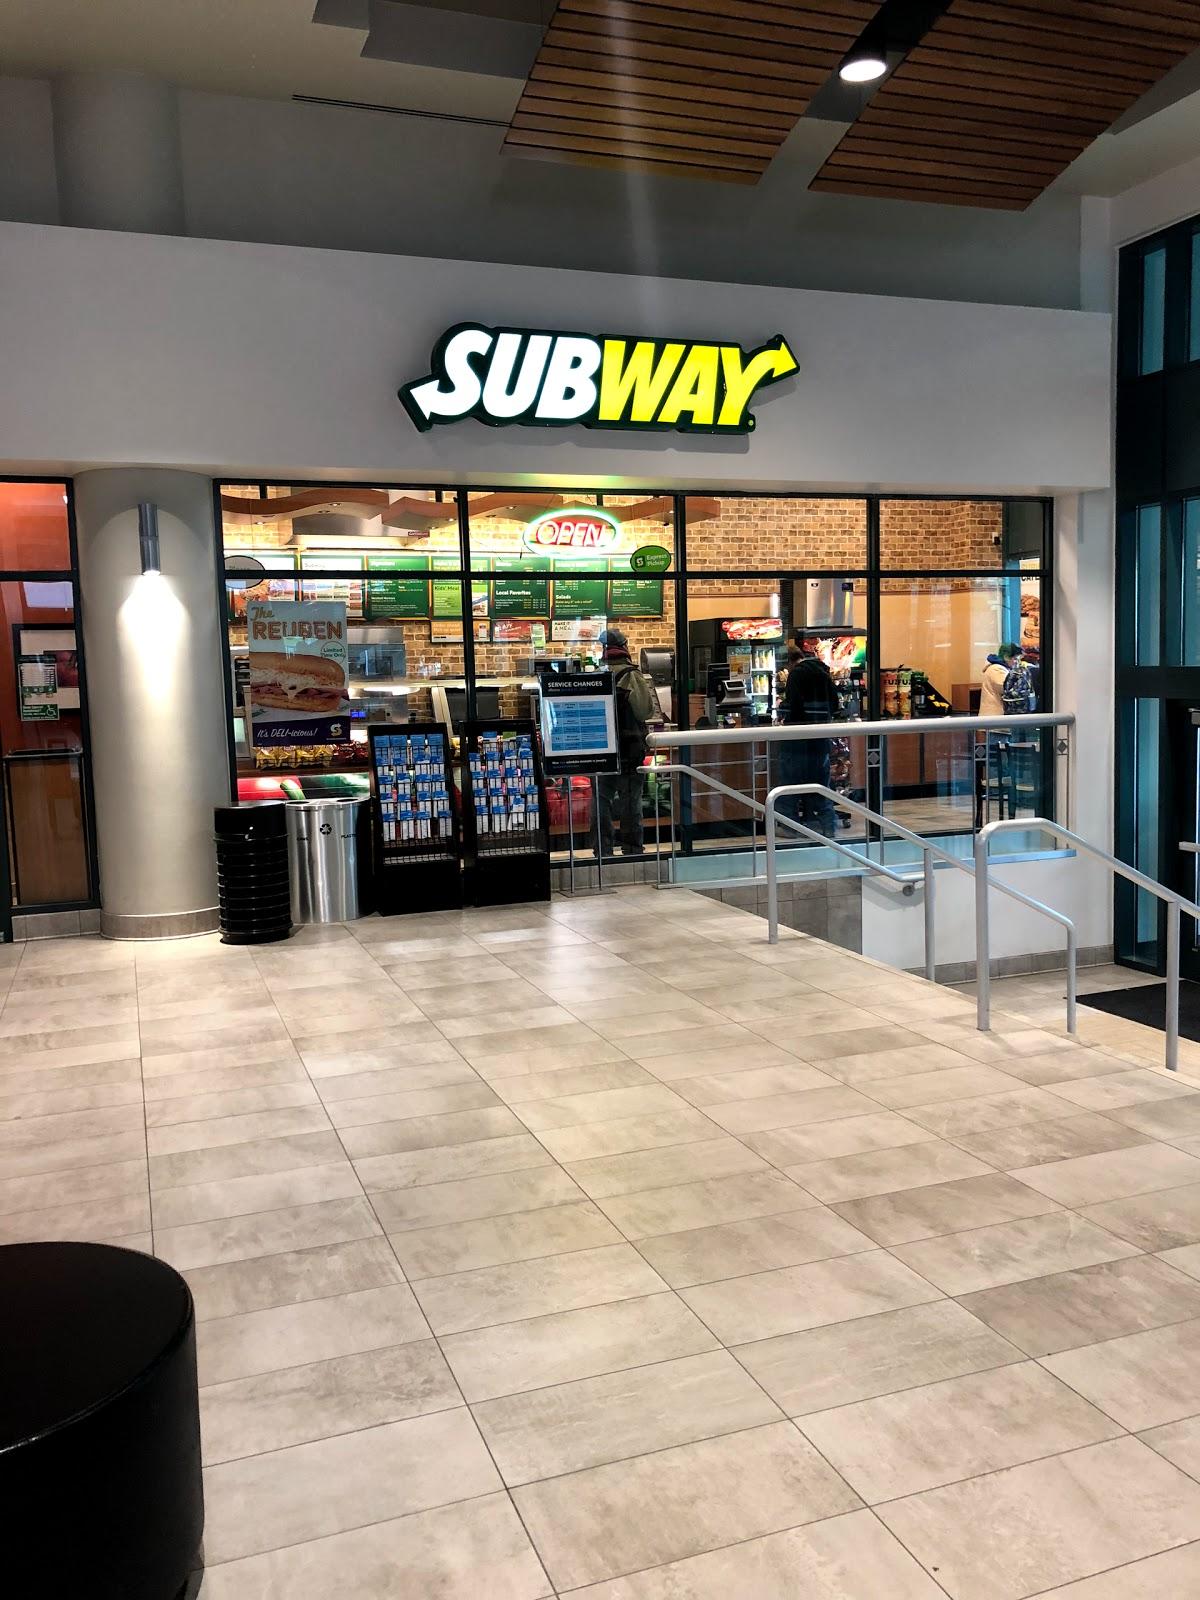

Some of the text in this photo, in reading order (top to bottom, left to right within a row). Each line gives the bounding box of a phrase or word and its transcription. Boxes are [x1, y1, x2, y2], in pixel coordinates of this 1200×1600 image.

[409, 329, 798, 426] SUBWAY
[536, 520, 606, 548] OPEN
[251, 606, 275, 621] The
[252, 621, 343, 640] REUBEN
[257, 727, 319, 738] It's DELI-icious!
